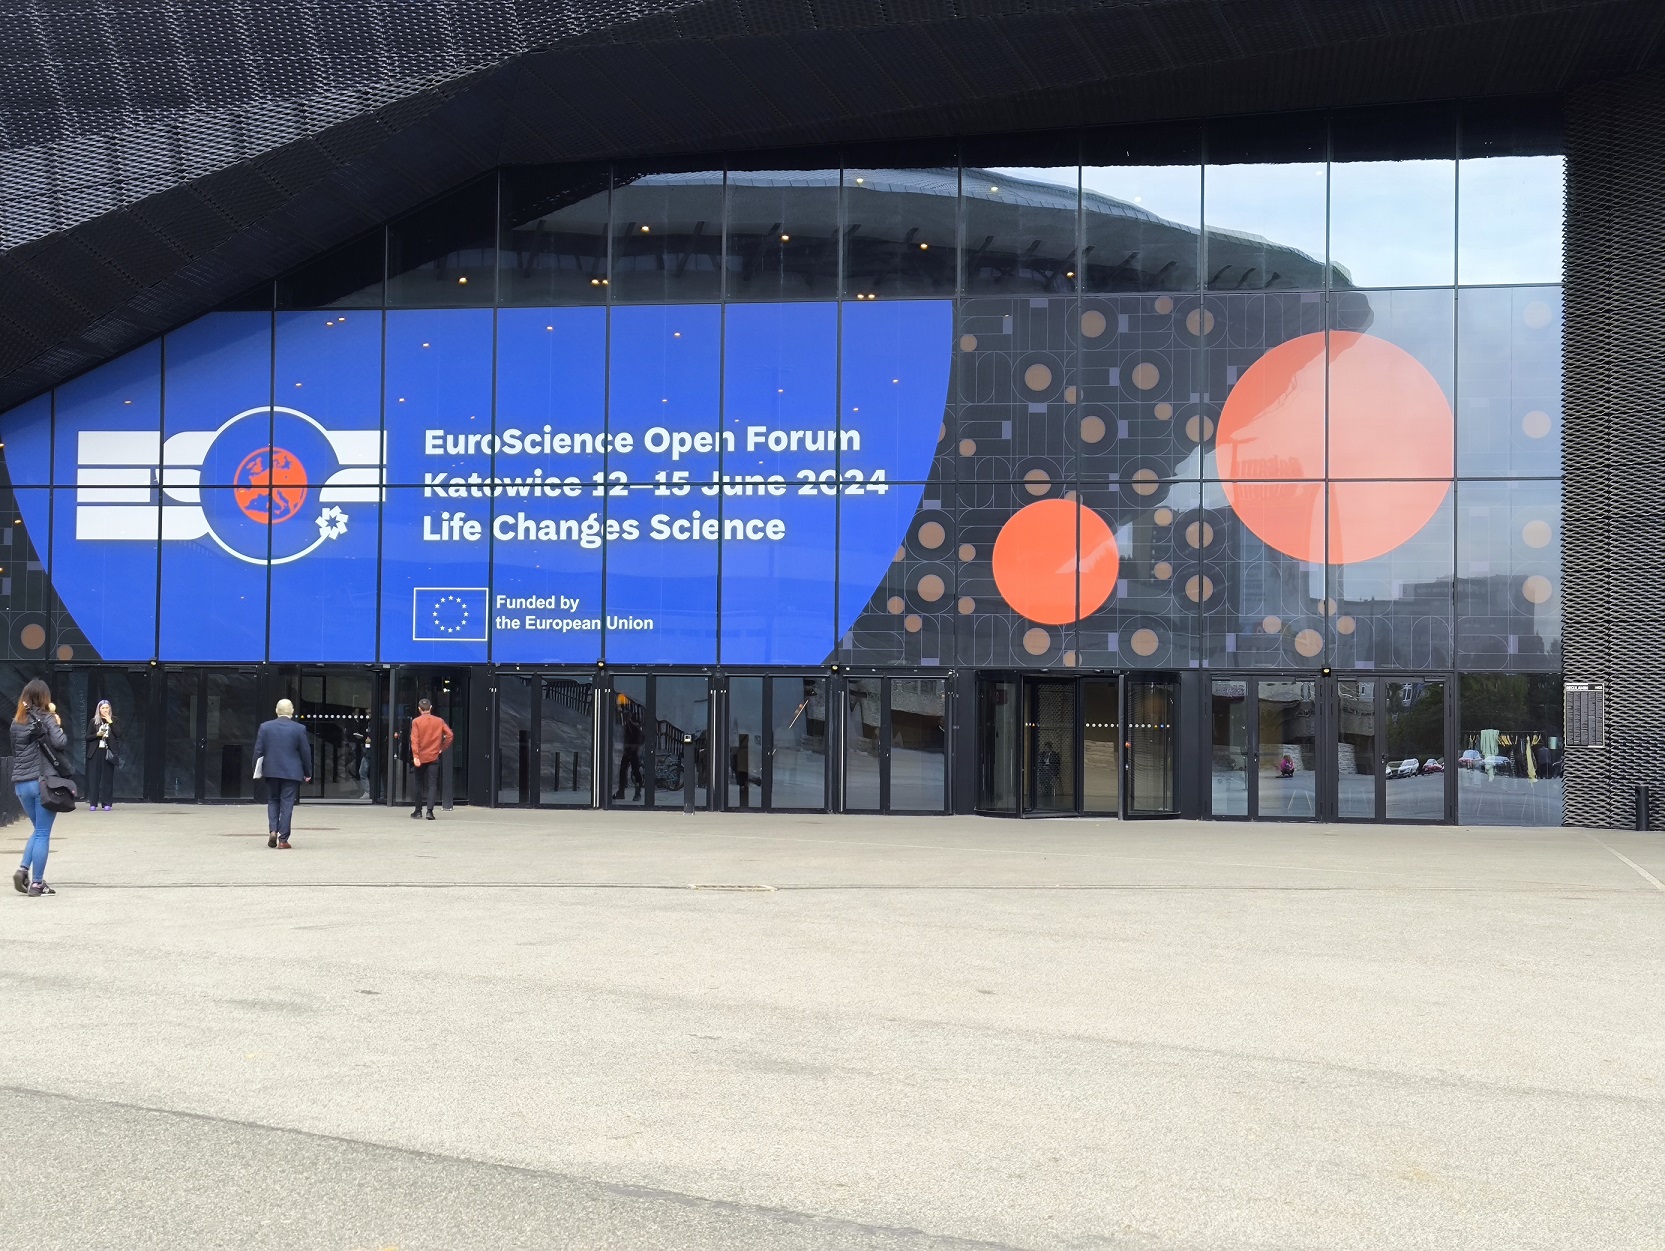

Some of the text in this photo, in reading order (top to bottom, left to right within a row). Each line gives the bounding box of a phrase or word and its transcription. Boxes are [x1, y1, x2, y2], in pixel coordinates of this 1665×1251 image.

[425, 424, 861, 461] EuroScience Open Forum
[424, 468, 582, 498] Katowice
[700, 470, 787, 496] June
[797, 469, 889, 495] 2024
[423, 510, 786, 549] Life Changes Science
[497, 595, 580, 613] Funded by
[496, 616, 654, 634] the European Union
